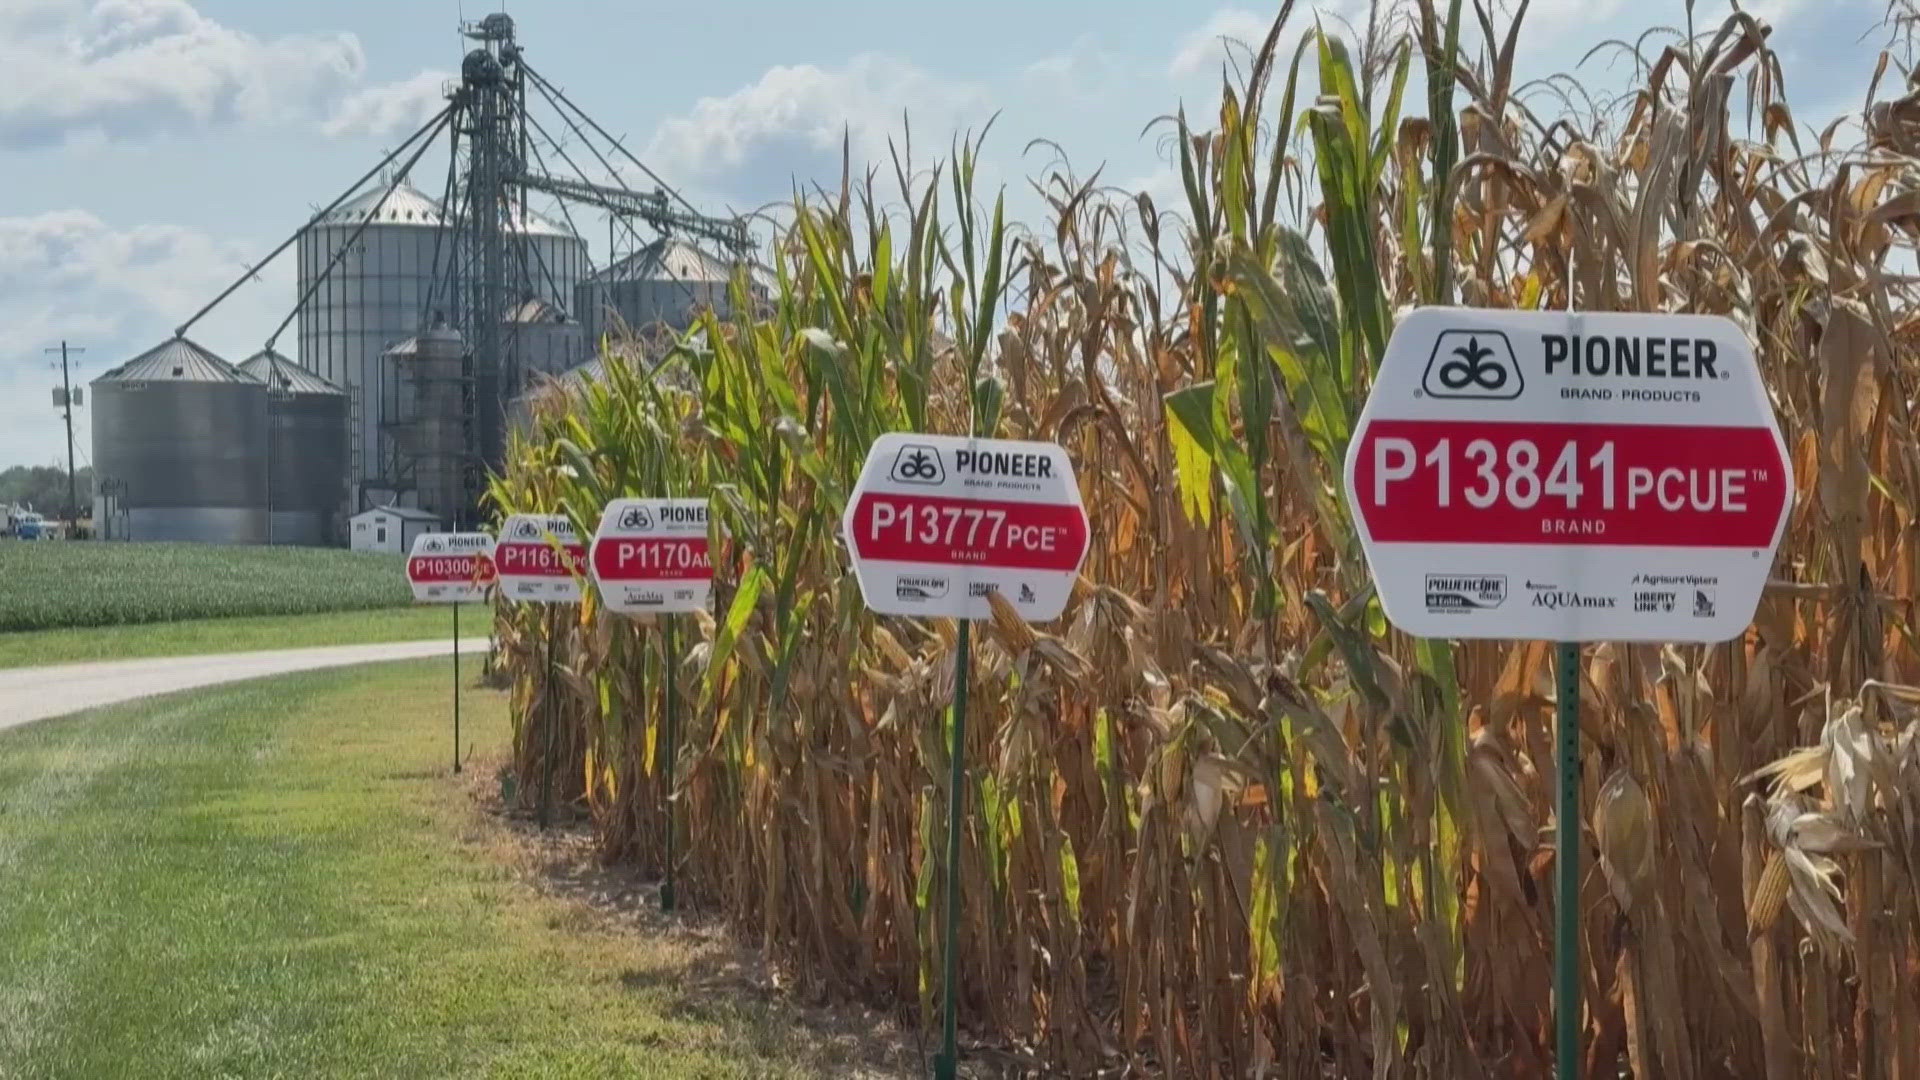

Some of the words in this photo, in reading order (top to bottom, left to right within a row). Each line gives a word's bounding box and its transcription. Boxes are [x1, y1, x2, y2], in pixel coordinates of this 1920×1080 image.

[1560, 387, 1612, 400] BRAND
[1621, 389, 1701, 402] PRODUCTS
[955, 449, 1052, 478] PIONEER
[964, 479, 993, 489] BRAND
[1541, 519, 1606, 534] BRAND
[951, 551, 987, 561] BRAND
[1532, 591, 1616, 610] AQUAmax
[1634, 591, 1676, 603] LIBERTY
[1634, 602, 1658, 612] LINK
